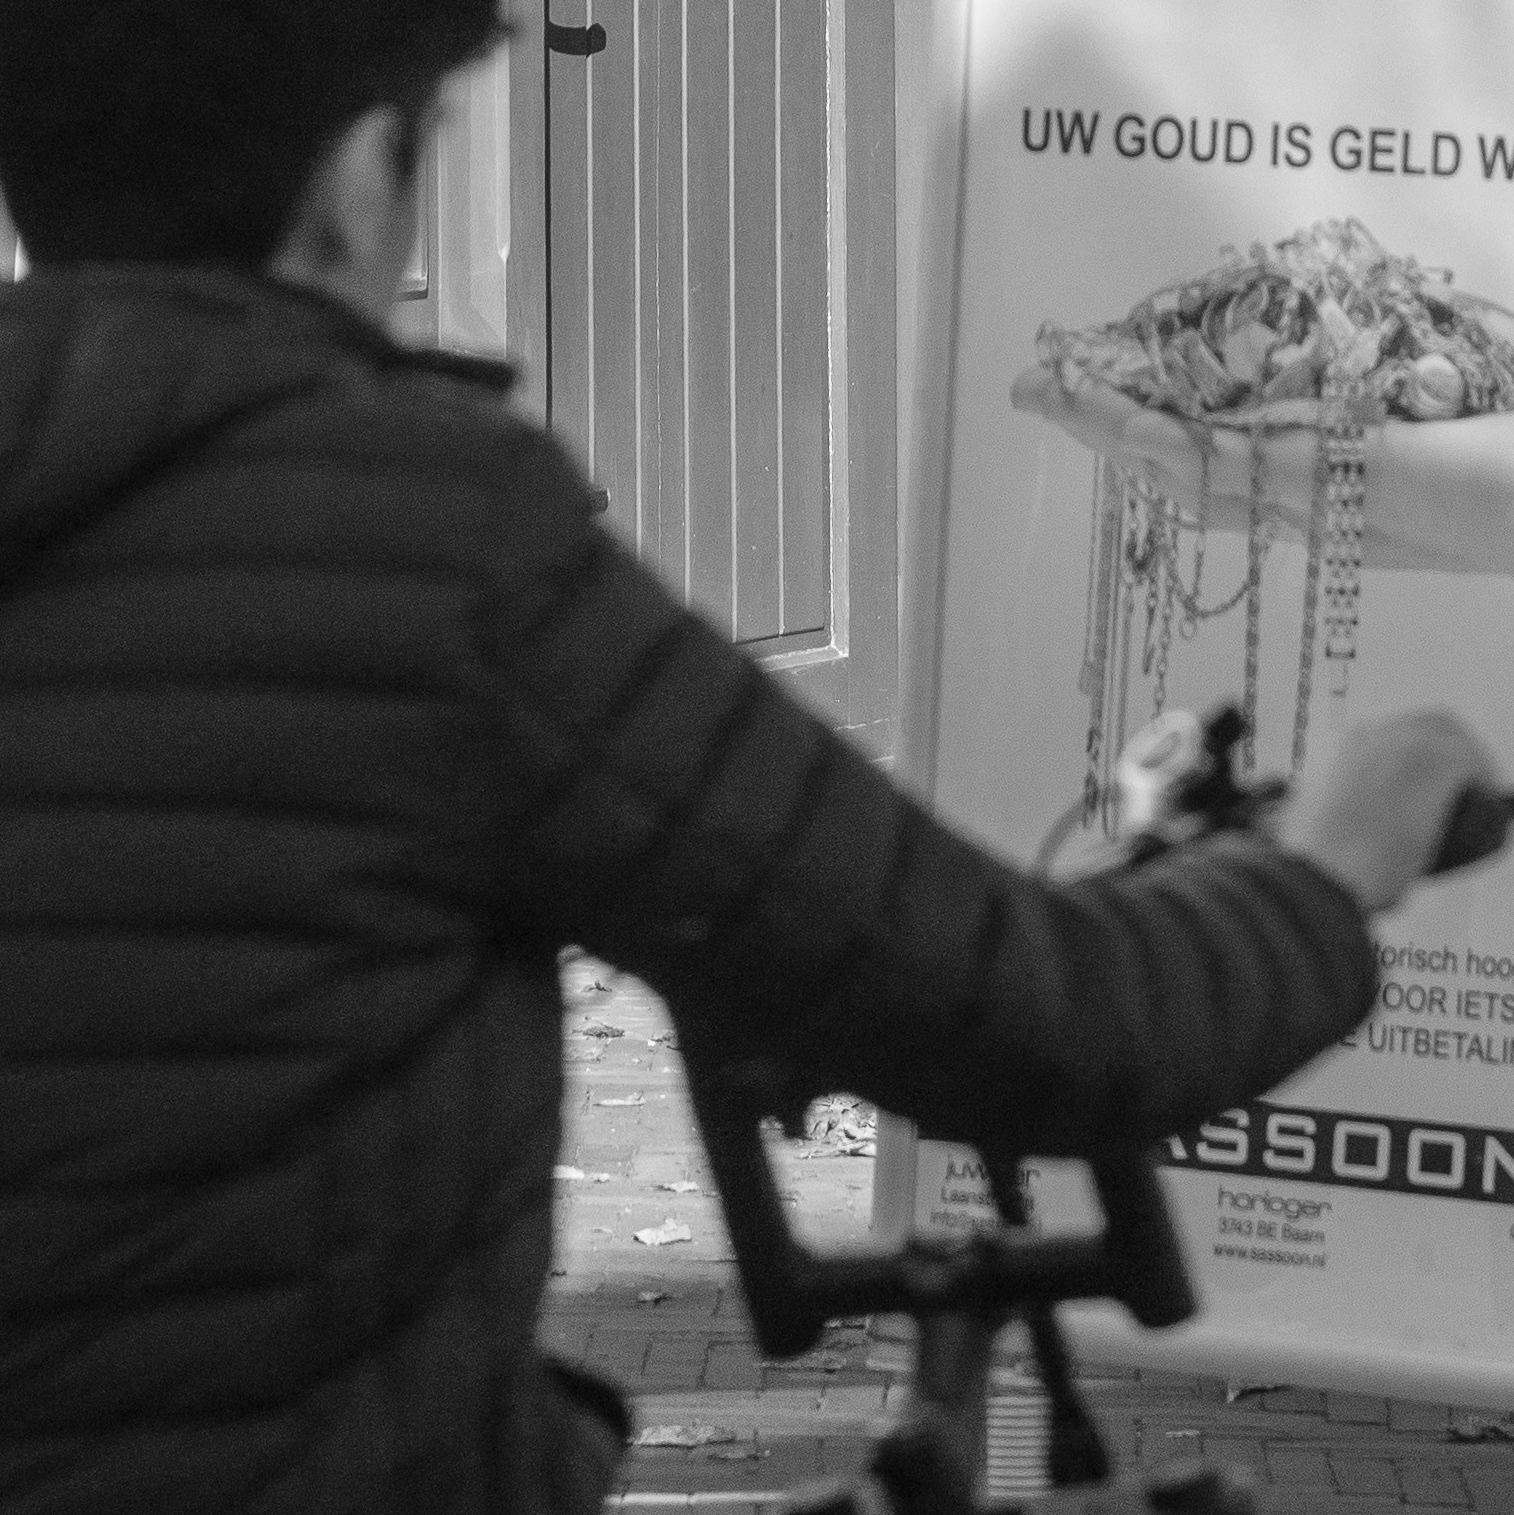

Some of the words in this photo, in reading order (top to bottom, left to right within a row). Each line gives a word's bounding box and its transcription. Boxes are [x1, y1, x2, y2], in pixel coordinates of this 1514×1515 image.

[1021, 106, 1101, 156] UW
[1113, 112, 1254, 164] GOUD
[1271, 122, 1313, 169] IS
[1329, 124, 1462, 178] GELD
